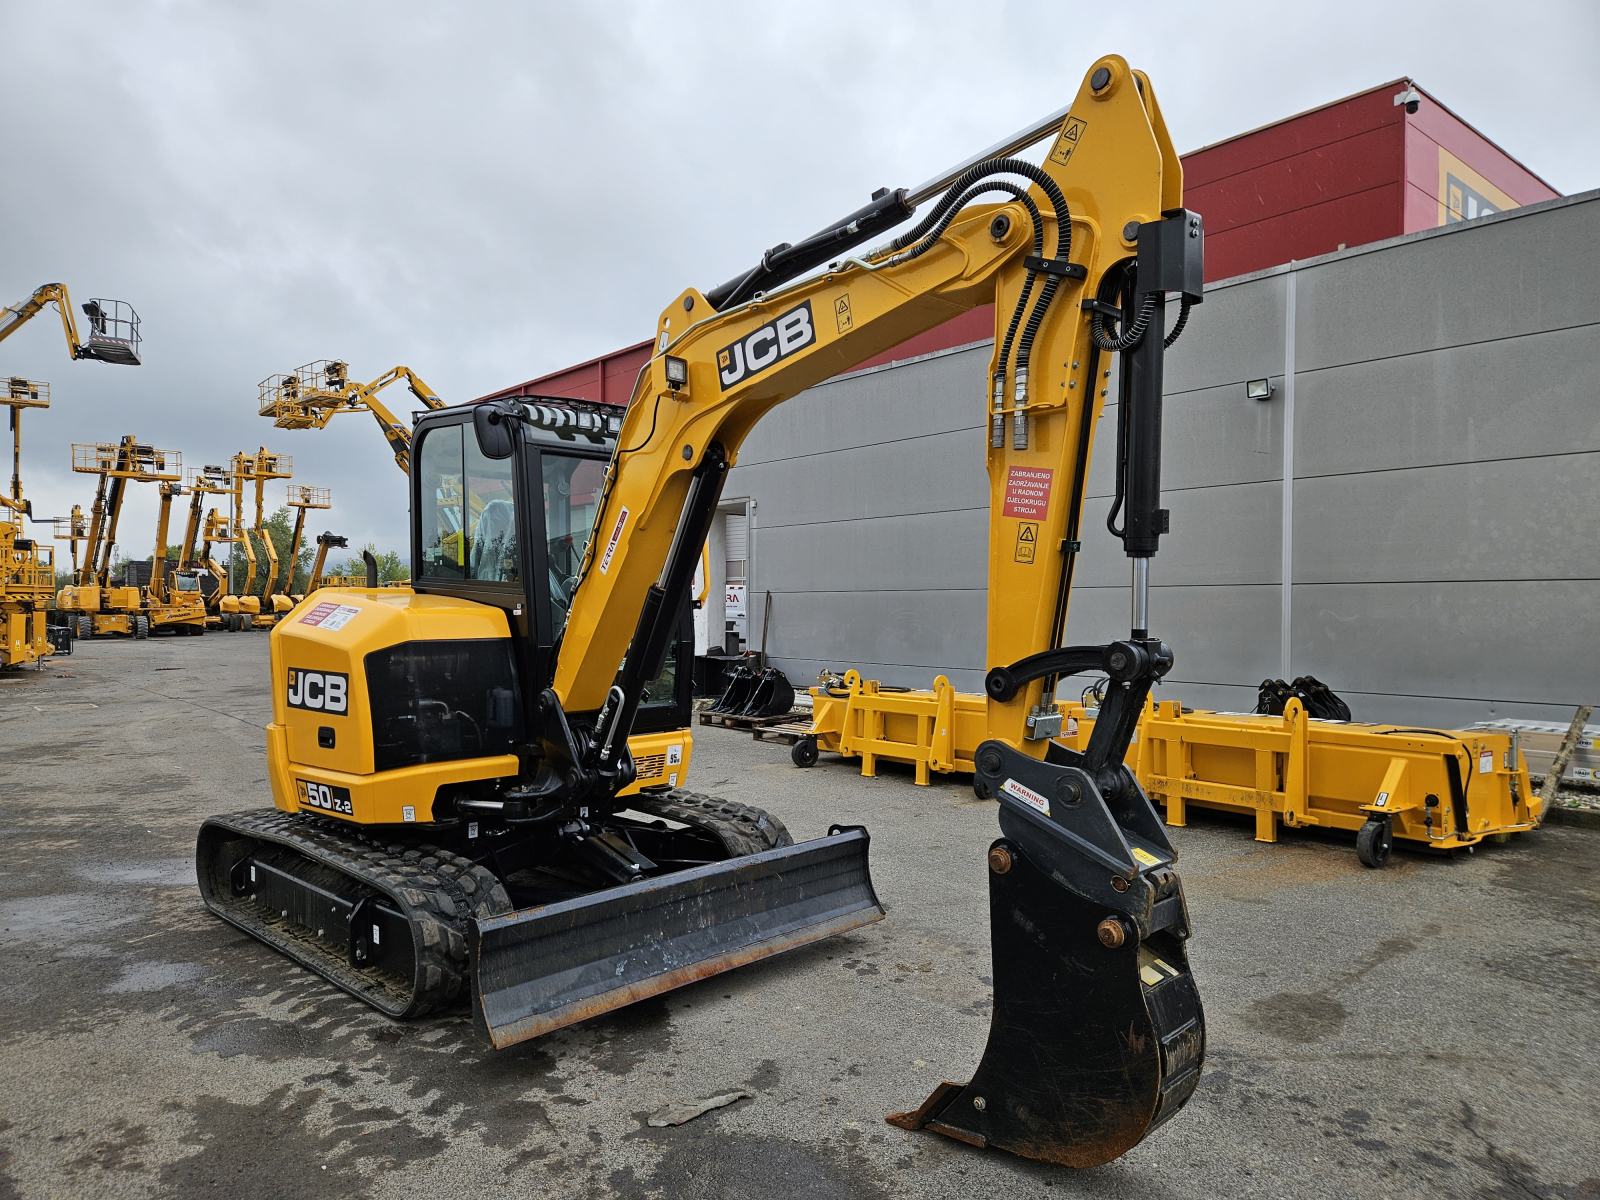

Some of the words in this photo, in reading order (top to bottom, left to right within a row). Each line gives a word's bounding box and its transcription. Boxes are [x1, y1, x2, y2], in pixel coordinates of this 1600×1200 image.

[721, 307, 813, 386] JCB
[1010, 470, 1051, 480] ZABRANJENO
[1017, 489, 1044, 497] RADNOM
[1013, 506, 1037, 515] STROJA
[288, 671, 347, 712] JCB
[306, 783, 332, 810] 50
[1010, 782, 1045, 806] WARNING
